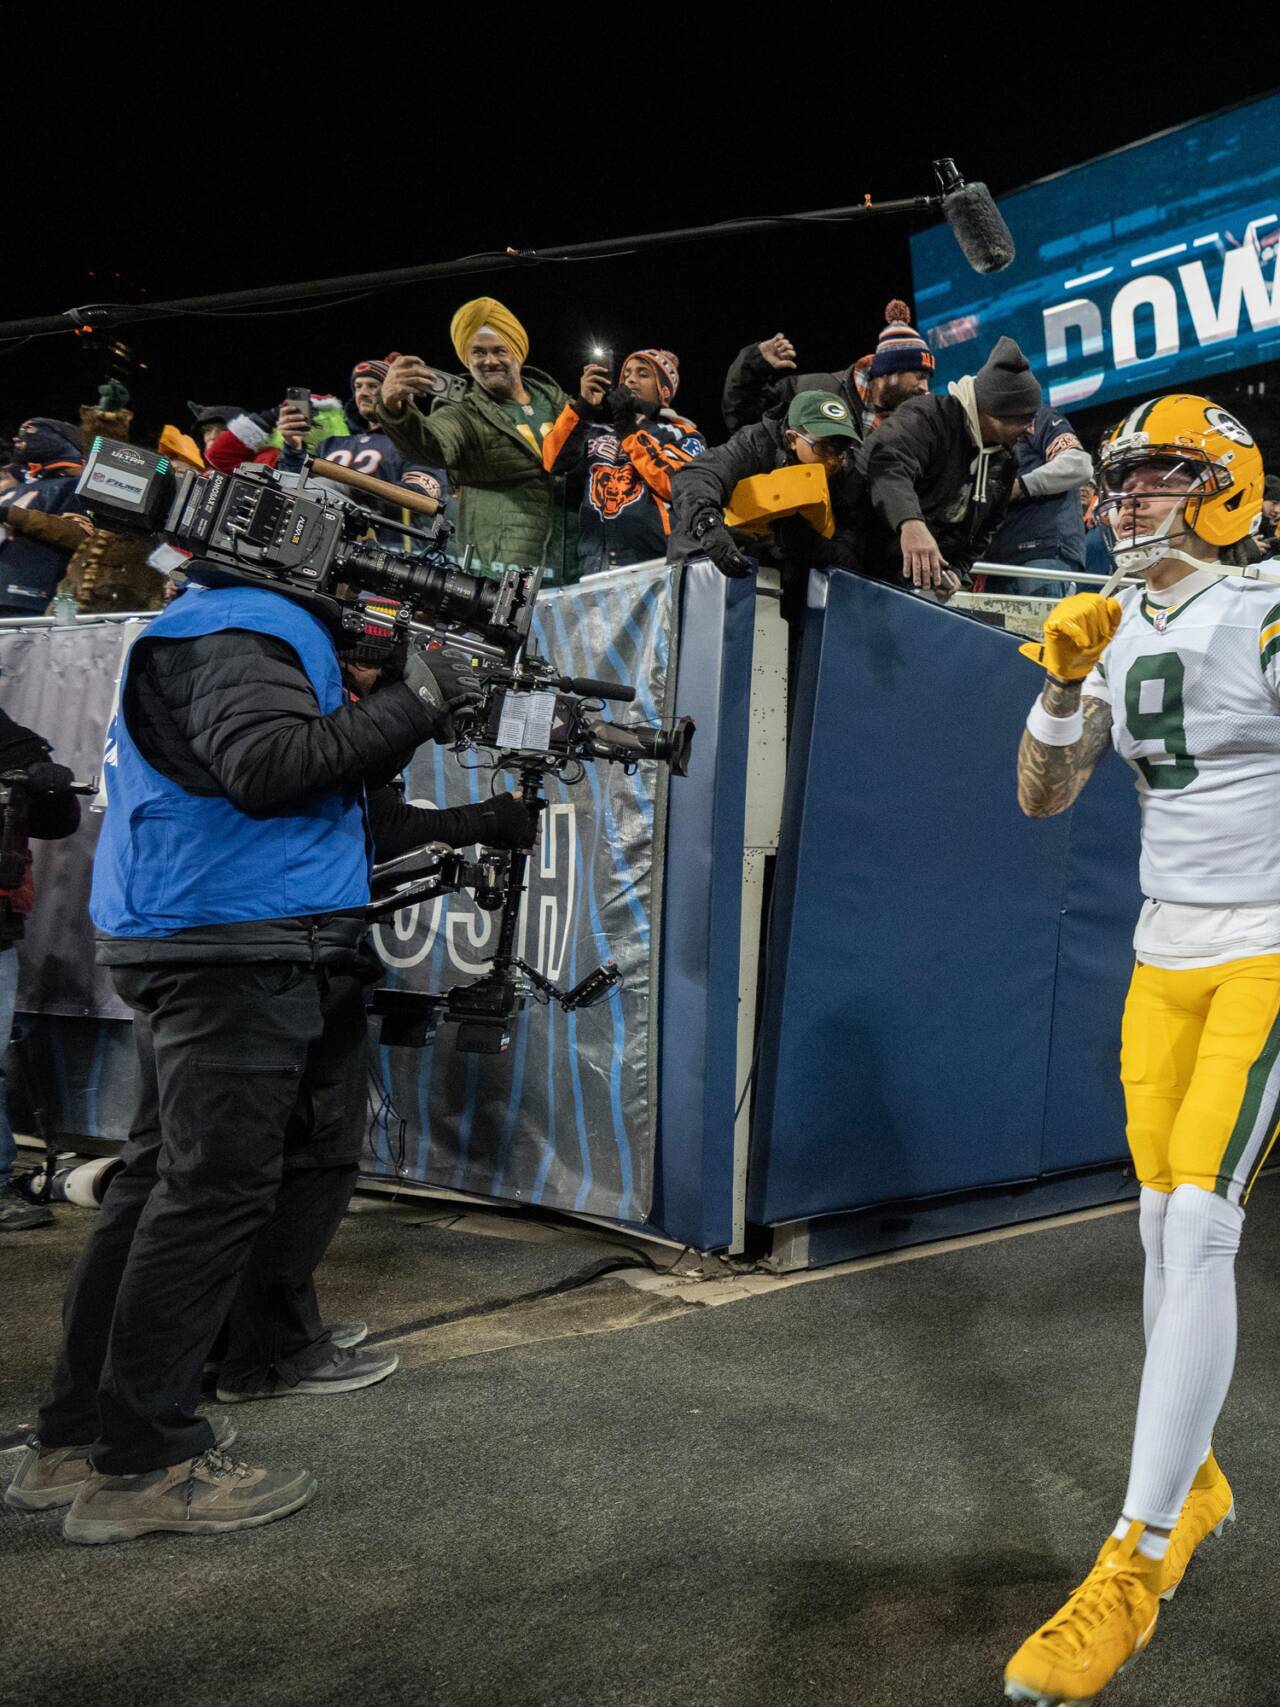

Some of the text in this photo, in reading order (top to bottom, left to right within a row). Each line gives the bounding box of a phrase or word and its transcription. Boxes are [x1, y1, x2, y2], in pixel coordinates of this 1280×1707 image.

[111, 450, 145, 466] ULTRA
[105, 477, 143, 494] FILMS
[208, 475, 224, 506] SONOSAX
[1124, 651, 1200, 790] 9
